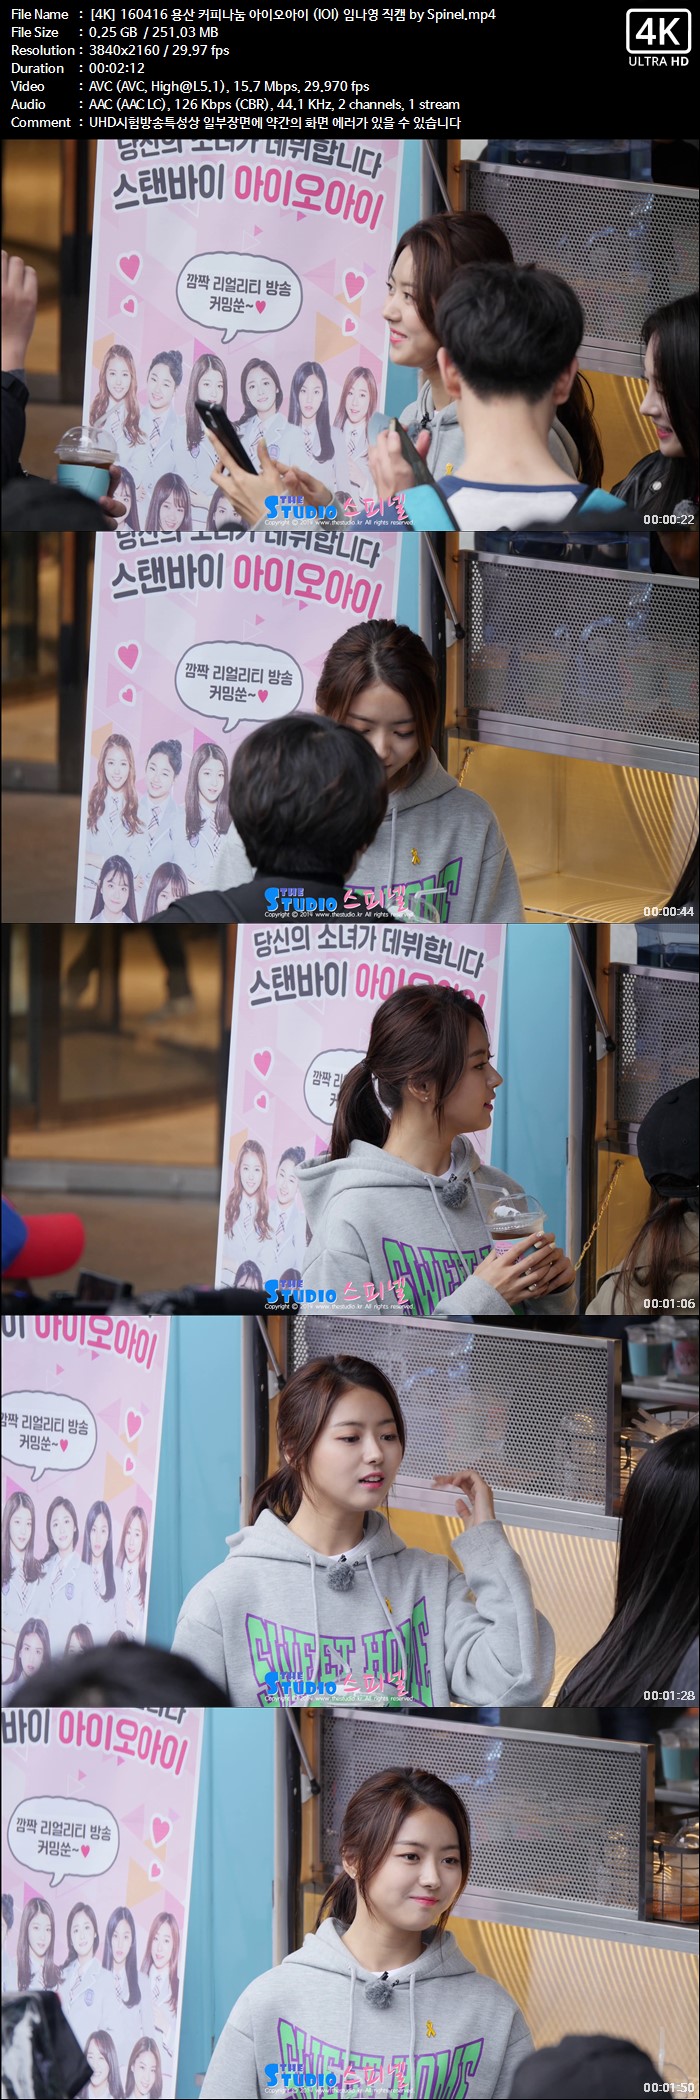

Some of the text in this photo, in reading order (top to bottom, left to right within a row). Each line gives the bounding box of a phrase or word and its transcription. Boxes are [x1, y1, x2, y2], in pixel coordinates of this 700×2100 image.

[113, 163, 384, 231] 스탠바이 아이오아이
[186, 273, 292, 297] 깜짝 리얼리티 방송
[111, 553, 382, 620] 스탠바이 아이오아이
[185, 662, 293, 686] 깜짝 리얼리티 방송
[254, 924, 485, 979] 당신의 소녀가 데뷔합니다
[249, 961, 347, 1006] 스탠바이
[312, 1070, 332, 1087] 깜짝
[35, 1315, 157, 1370] 아이오아이
[22, 1414, 65, 1433] 리얼리티
[68, 1419, 89, 1435] 방송
[59, 1710, 188, 1776] 아이오아이
[16, 1817, 111, 1841] 깜짝 리얼리티 방송
